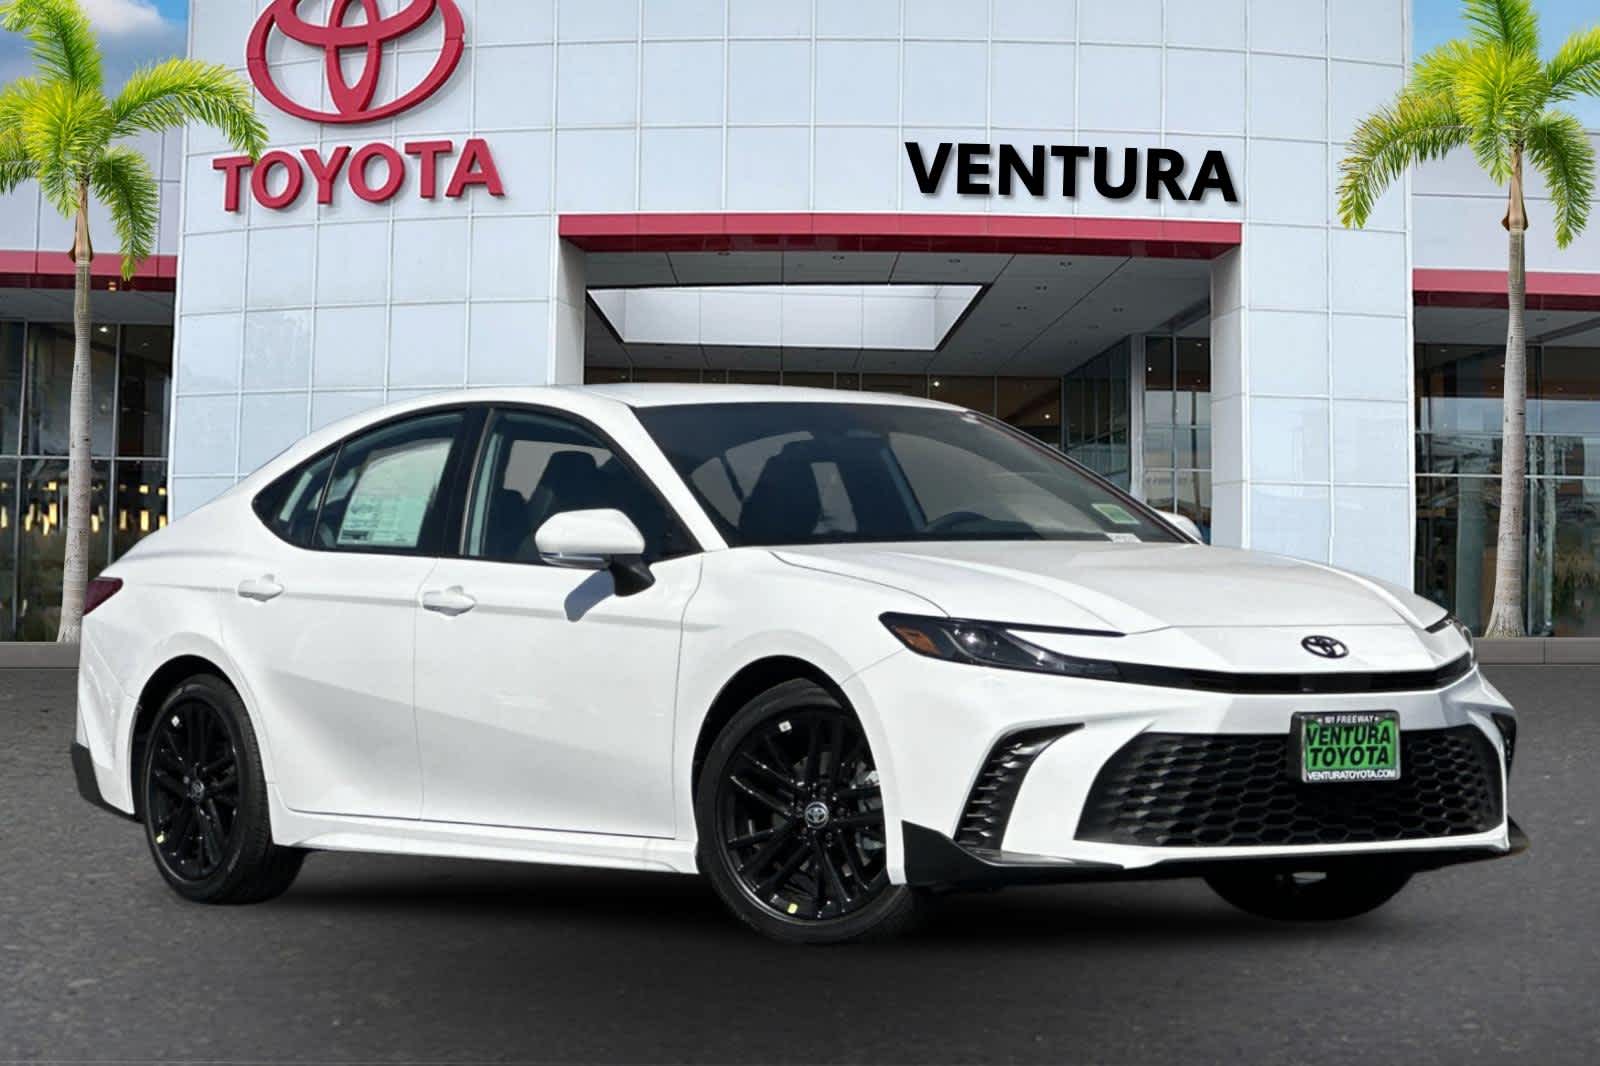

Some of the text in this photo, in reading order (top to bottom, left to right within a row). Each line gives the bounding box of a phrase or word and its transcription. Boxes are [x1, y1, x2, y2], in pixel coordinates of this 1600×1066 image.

[213, 139, 504, 212] TOYOTA
[905, 142, 1238, 202] VENTURA
[1336, 714, 1375, 724] FREEWAY
[1306, 726, 1391, 746] VENTURA
[1310, 746, 1389, 767] TOYOTA
[1307, 769, 1396, 780] VENTURATOYOTA.COM
